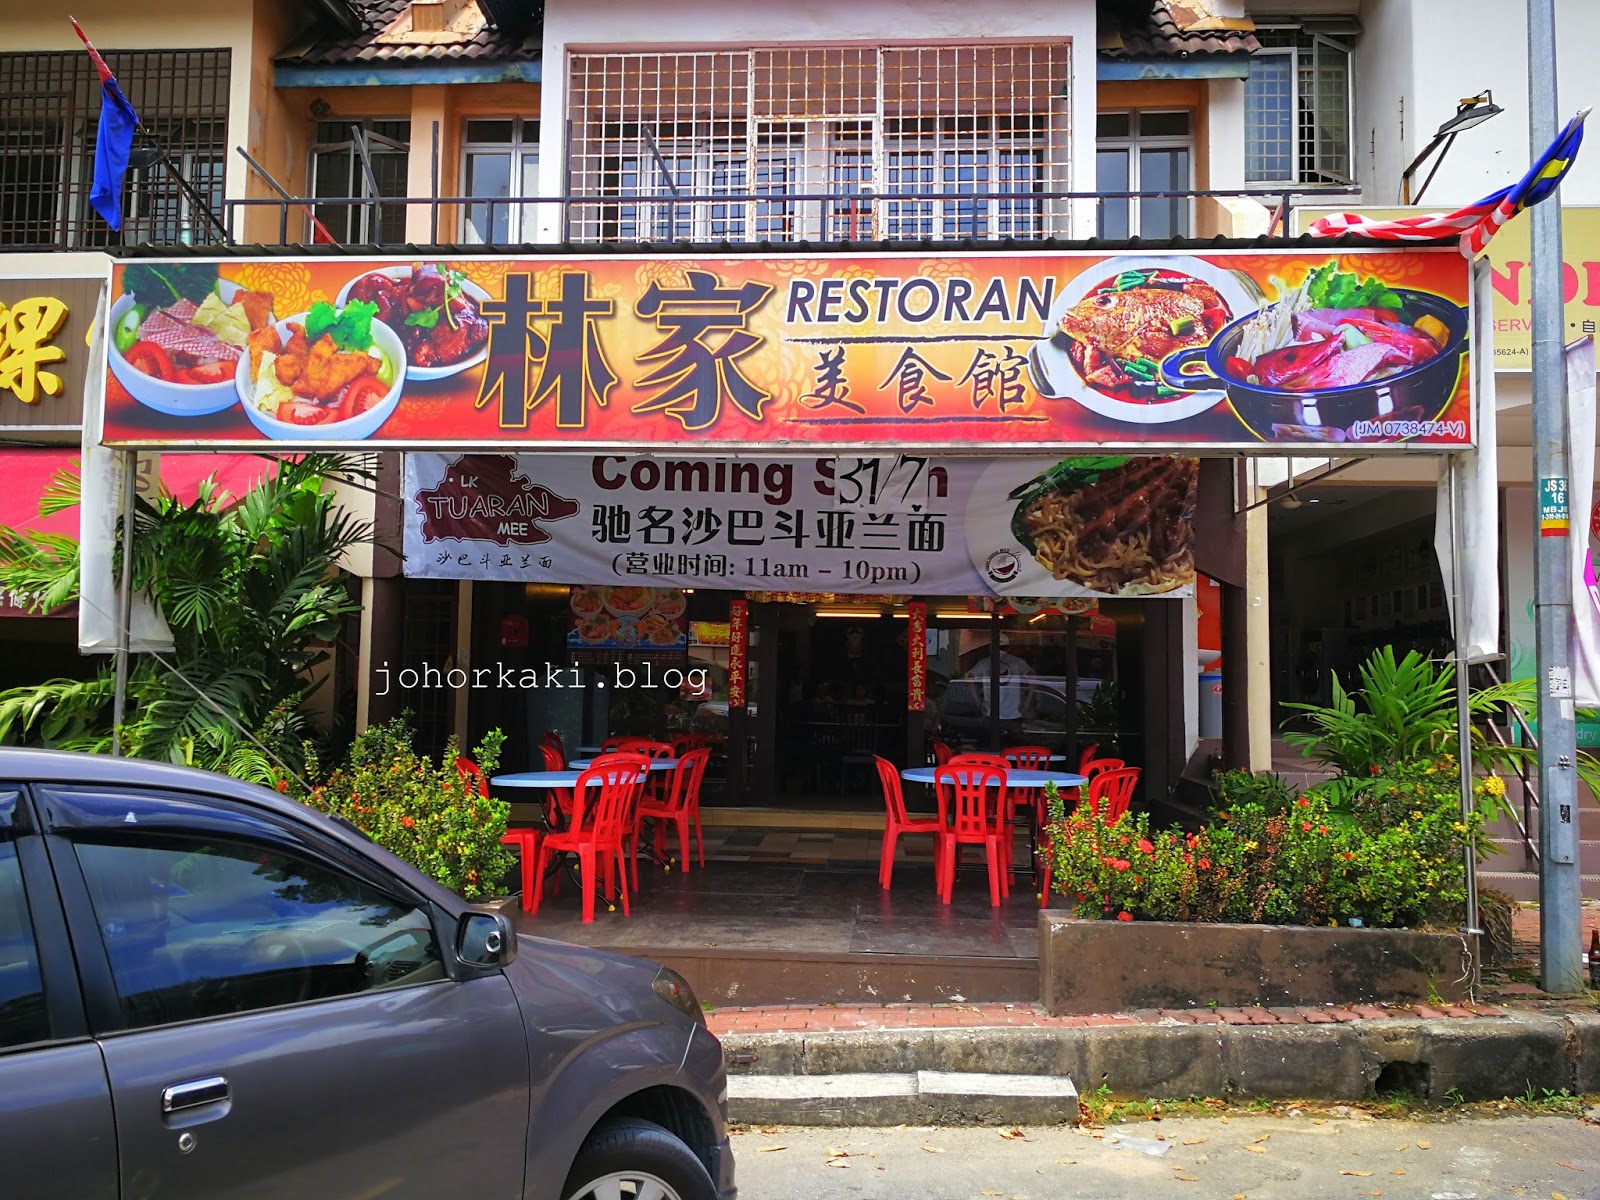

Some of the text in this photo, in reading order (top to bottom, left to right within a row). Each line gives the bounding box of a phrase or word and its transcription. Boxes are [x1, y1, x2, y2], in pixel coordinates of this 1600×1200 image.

[785, 277, 1055, 325] RESTORAN
[475, 271, 776, 431] 林家
[800, 346, 1031, 414] 美食館
[1353, 421, 1465, 438] (JM 0738474-V)
[460, 475, 479, 488] LK
[592, 455, 793, 505] Coming
[428, 493, 549, 519] TUARAN
[497, 522, 529, 537] MEE
[592, 504, 948, 552] 驰名沙巴斗亚兰面
[436, 551, 553, 569] 沙巴斗亚兰面
[746, 557, 809, 578] 11am
[842, 560, 922, 585] 10pm)
